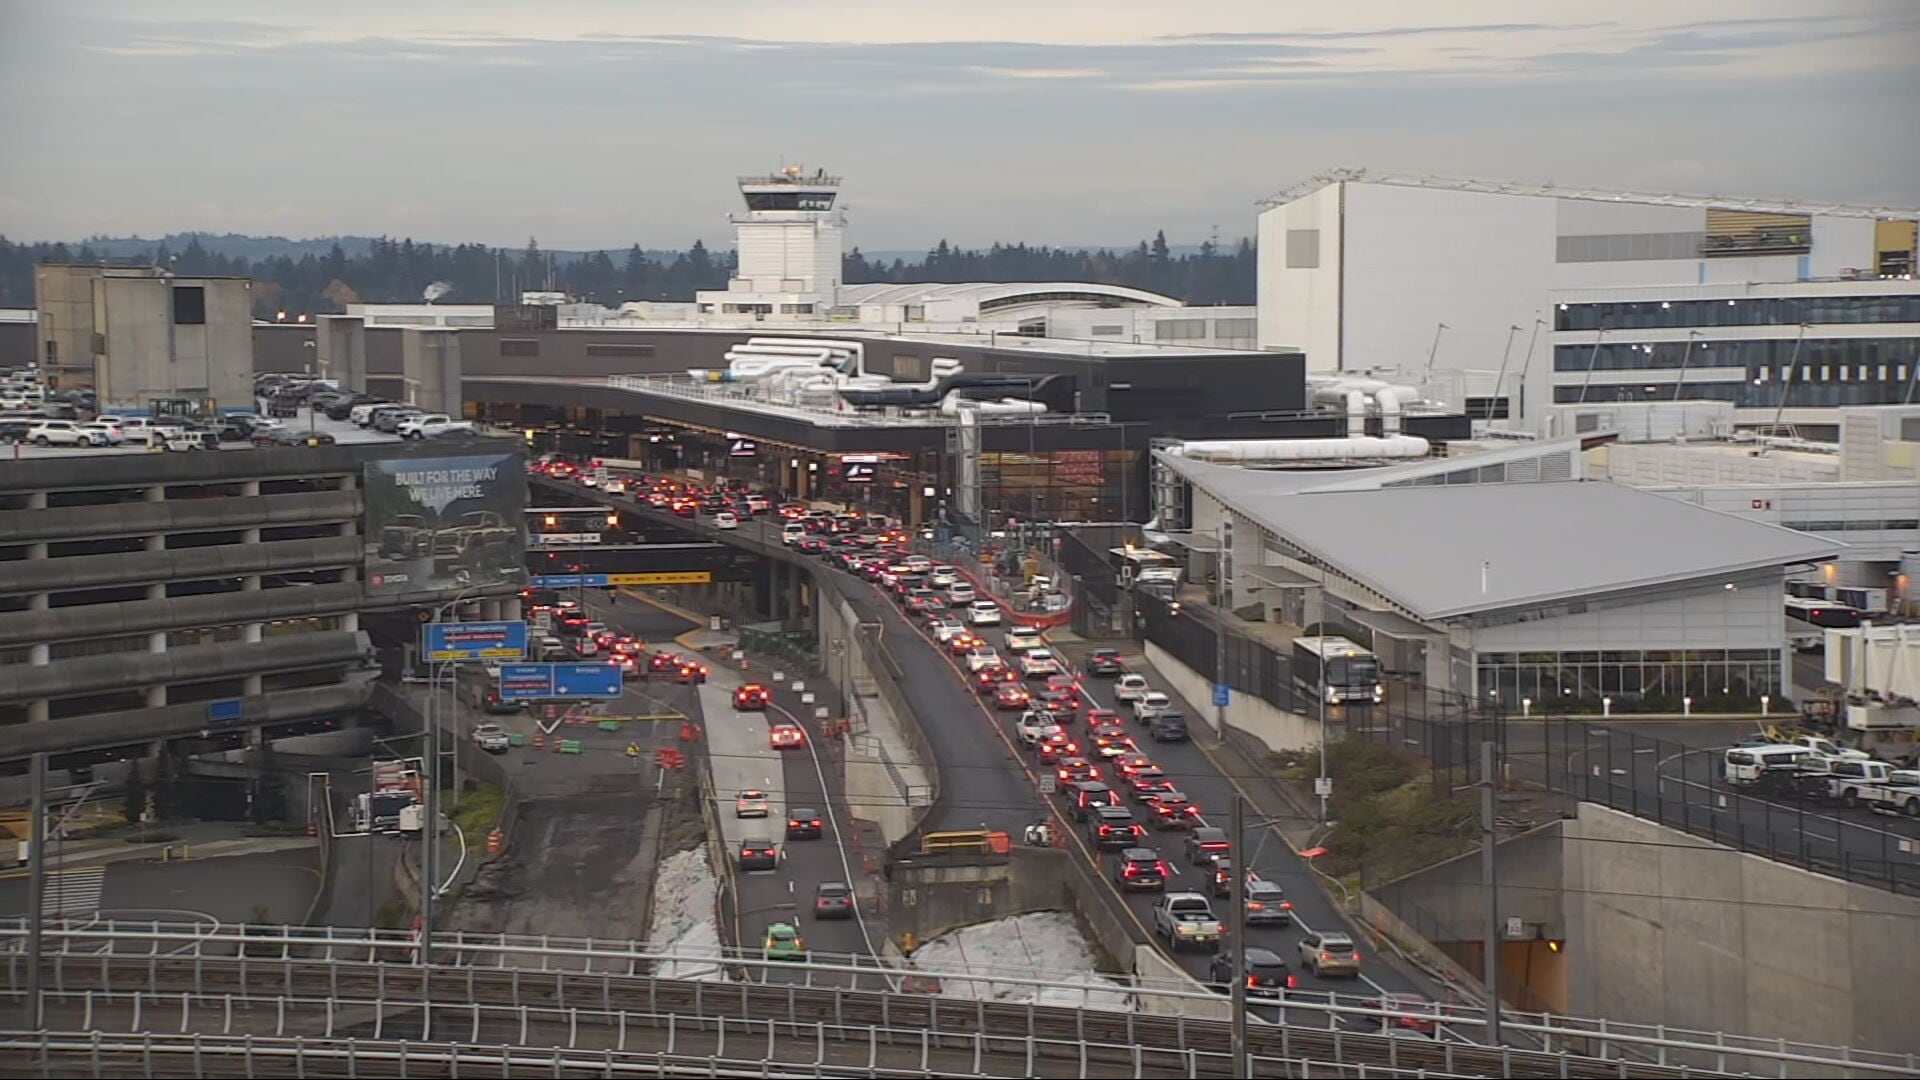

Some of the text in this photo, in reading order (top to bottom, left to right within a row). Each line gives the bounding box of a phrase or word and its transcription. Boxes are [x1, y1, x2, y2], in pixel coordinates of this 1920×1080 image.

[395, 467, 498, 486] BUILT FOR THE WAY
[408, 487, 429, 502] WE
[429, 485, 452, 501] LIVE
